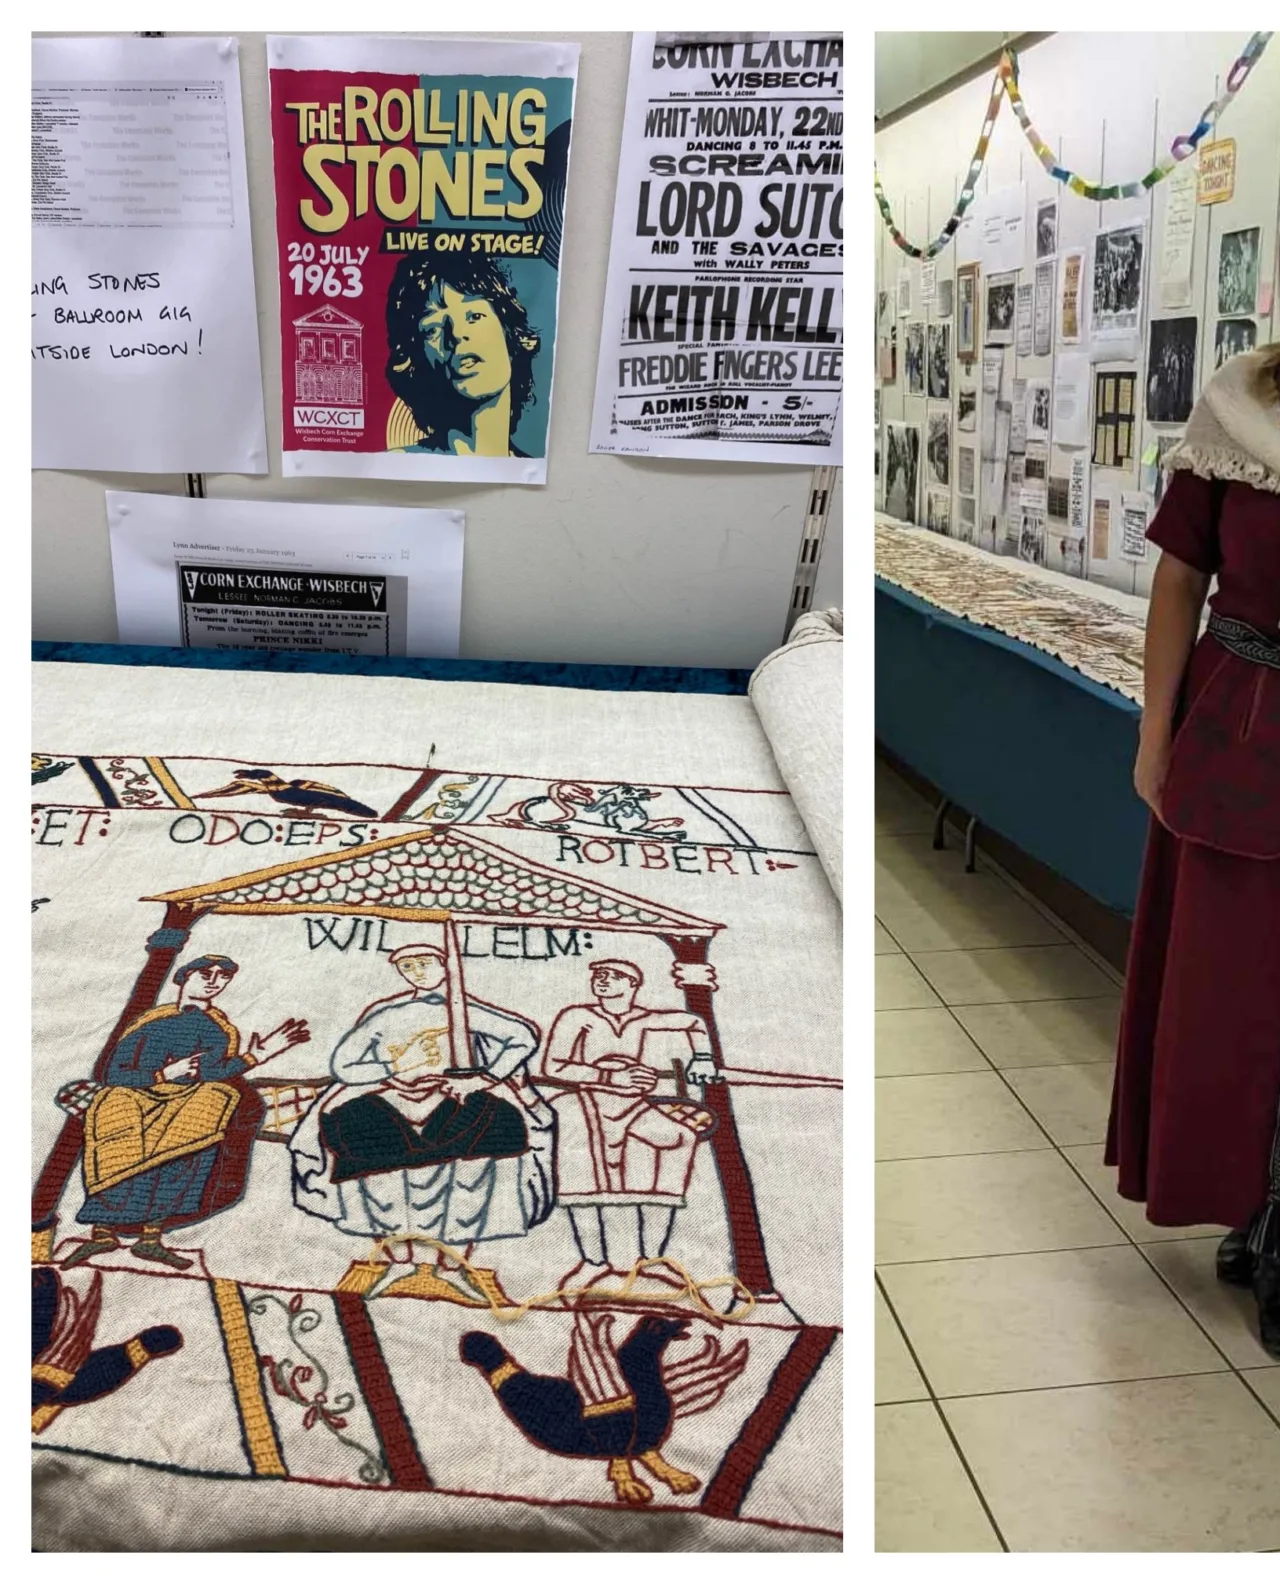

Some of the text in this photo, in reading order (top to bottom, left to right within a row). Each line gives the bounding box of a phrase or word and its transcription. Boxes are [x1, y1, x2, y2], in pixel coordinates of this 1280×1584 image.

[711, 71, 838, 88] WISBECH
[285, 86, 548, 146] THE ROLLING
[644, 107, 785, 139] WHIT-MONDAY,
[686, 141, 742, 151] DANCING
[749, 141, 756, 151] 8
[763, 141, 779, 150] TO
[786, 141, 811, 150] 11.45
[650, 153, 843, 176] SCREAMI
[300, 143, 546, 233] STONES
[636, 181, 743, 238] LORD
[386, 232, 545, 255] LIVE ON STAGE!
[651, 241, 679, 255] AND
[692, 241, 718, 255] THE
[287, 242, 370, 266] 20 JULY
[694, 260, 810, 270] with WALLY PETERS
[88, 273, 160, 292] STONES
[288, 263, 364, 298] 1963
[54, 305, 191, 323] BALLROOM GIG
[628, 284, 843, 345] KEITH KELL
[619, 352, 708, 388] FREDDIE
[713, 350, 798, 382] FNGERS
[297, 410, 361, 426] WCXCT
[655, 423, 689, 432] SUTTON,
[730, 420, 755, 428] JAMES,
[676, 414, 702, 422] DANCE
[337, 430, 364, 438] Exchange
[190, 542, 220, 551] Advertiser
[226, 546, 245, 554] Friday
[256, 549, 280, 557] January
[200, 572, 367, 593] CORN EXCHANGE WISBECH
[218, 592, 248, 601] LESSEE
[254, 594, 290, 603] NORMAN
[304, 597, 343, 606] JACOBS
[192, 606, 218, 614] Tonight
[288, 611, 324, 620] SKATING
[278, 620, 314, 629] DANCING
[253, 635, 323, 645] PRINCE NIKKI
[304, 917, 395, 953] WIL
